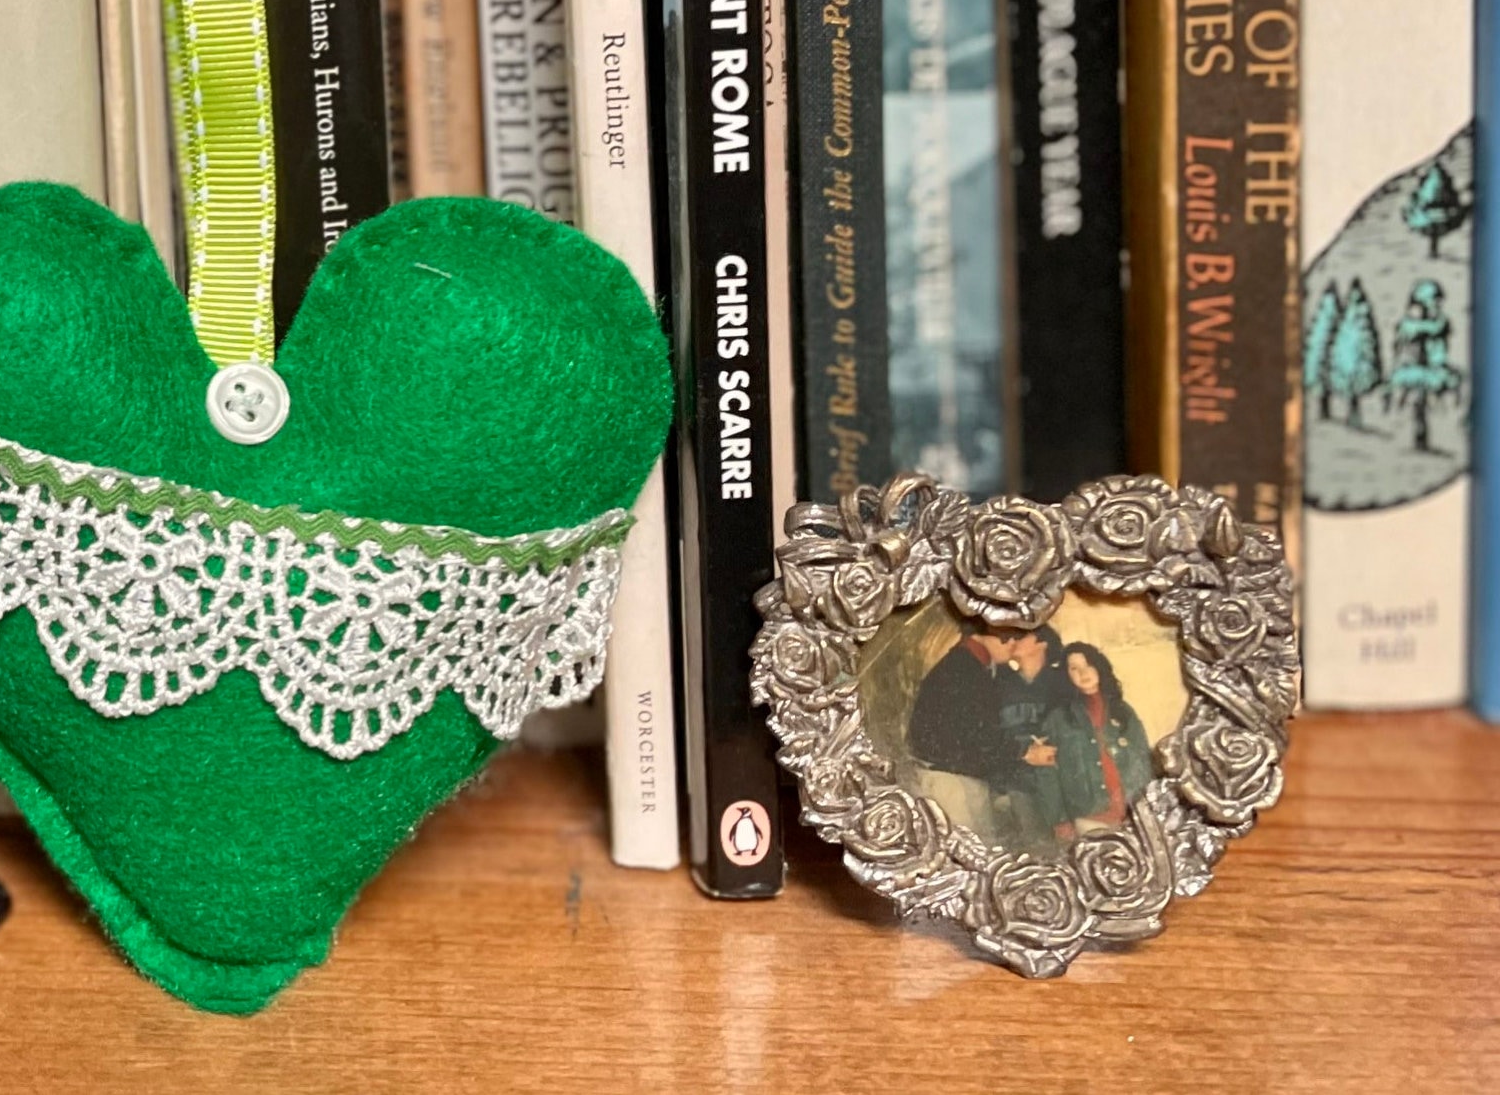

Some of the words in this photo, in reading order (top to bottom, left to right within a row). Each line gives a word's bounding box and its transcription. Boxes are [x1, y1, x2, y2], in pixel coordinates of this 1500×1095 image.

[534, 41, 567, 68] &
[1244, 11, 1298, 89] OF
[314, 66, 340, 162] Hurons
[601, 32, 631, 170] Reutlinger
[710, 49, 751, 175] ROME
[320, 167, 348, 213] and
[825, 169, 854, 212] the
[1185, 135, 1234, 243] Louis
[1244, 119, 1300, 226] THE
[714, 253, 749, 356] CHRIS
[824, 224, 857, 308] Guide
[1185, 254, 1235, 290] B.
[829, 318, 857, 347] to
[1180, 295, 1235, 425] Wright
[715, 364, 753, 501] SCARRE
[826, 358, 859, 417] Rule
[635, 689, 657, 816] WORCESTER
